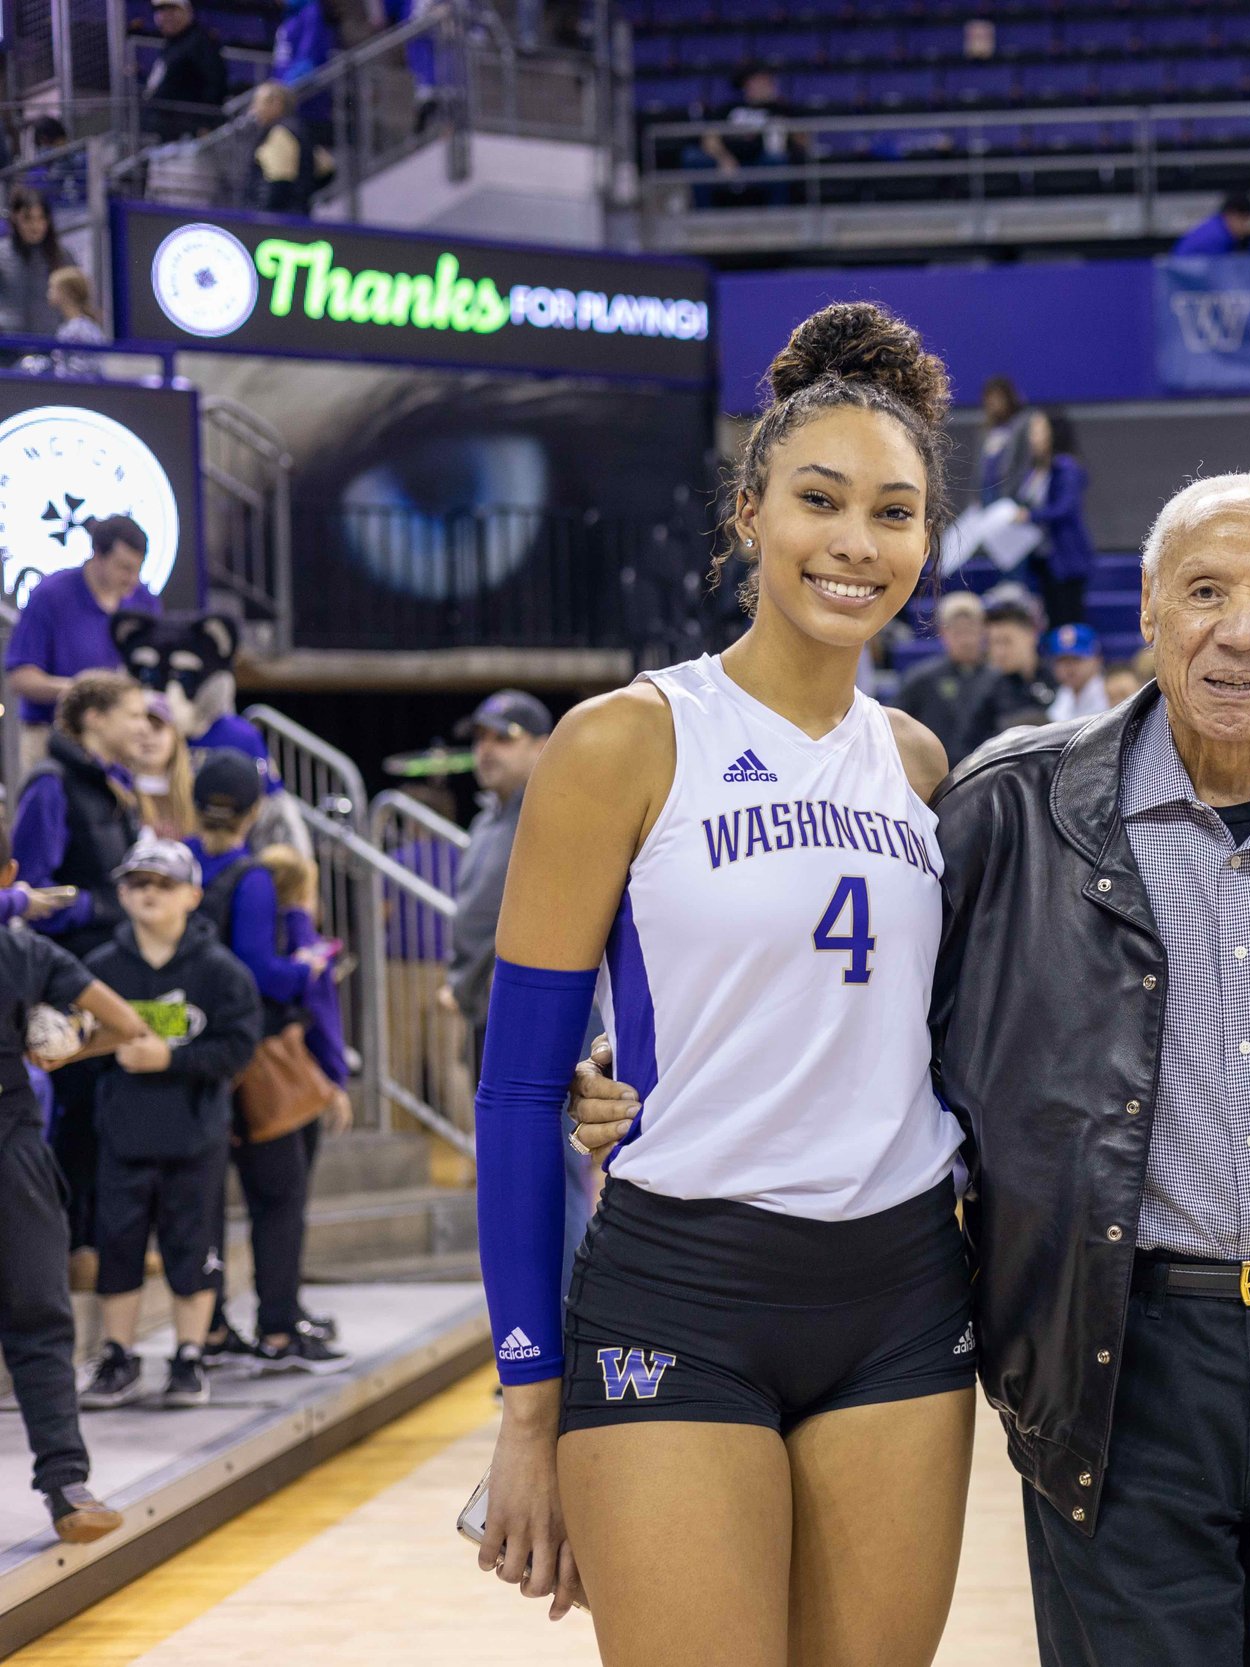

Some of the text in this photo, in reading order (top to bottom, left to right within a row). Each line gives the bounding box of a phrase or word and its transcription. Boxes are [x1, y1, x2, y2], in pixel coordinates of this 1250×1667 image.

[256, 238, 509, 333] Thanks
[510, 284, 577, 331] FOR
[576, 290, 708, 341] PLAYING!
[722, 768, 778, 783] adidas
[702, 800, 940, 880] WASHINGTON
[811, 873, 878, 986] 4
[499, 1344, 541, 1361] adidas
[597, 1346, 677, 1401] W
